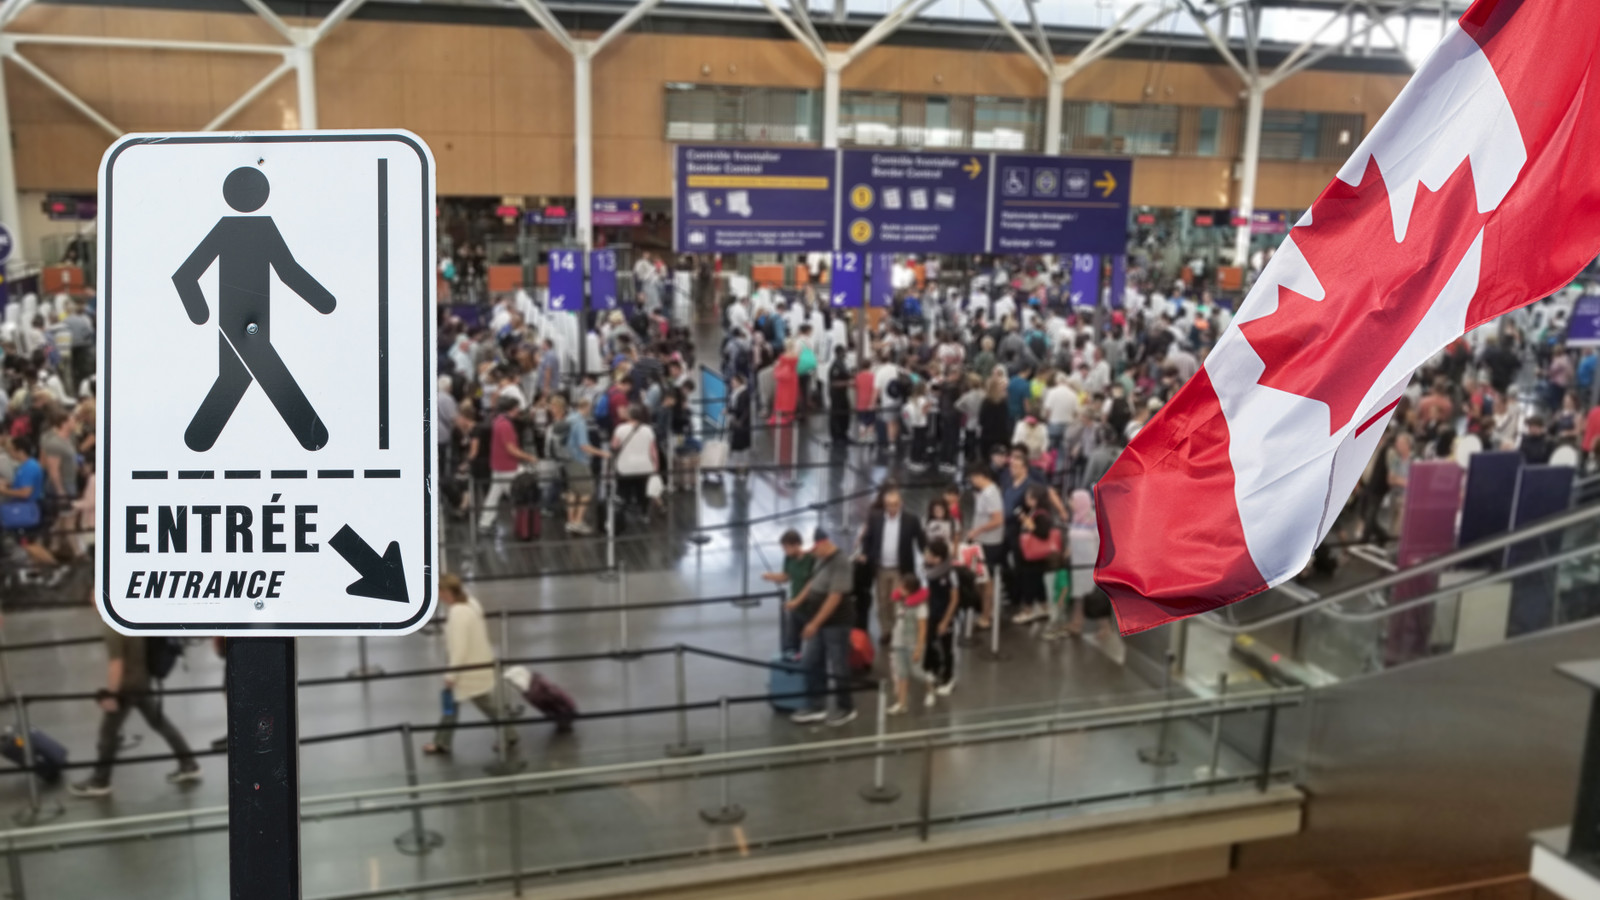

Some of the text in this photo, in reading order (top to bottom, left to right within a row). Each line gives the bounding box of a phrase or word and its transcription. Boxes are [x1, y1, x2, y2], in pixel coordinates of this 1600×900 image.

[550, 251, 575, 272] 14
[597, 251, 616, 272] 13
[835, 252, 858, 272] 12
[1073, 253, 1094, 272] 10
[125, 493, 320, 553] ENTRÉE
[125, 570, 286, 599] ENTRANCE
